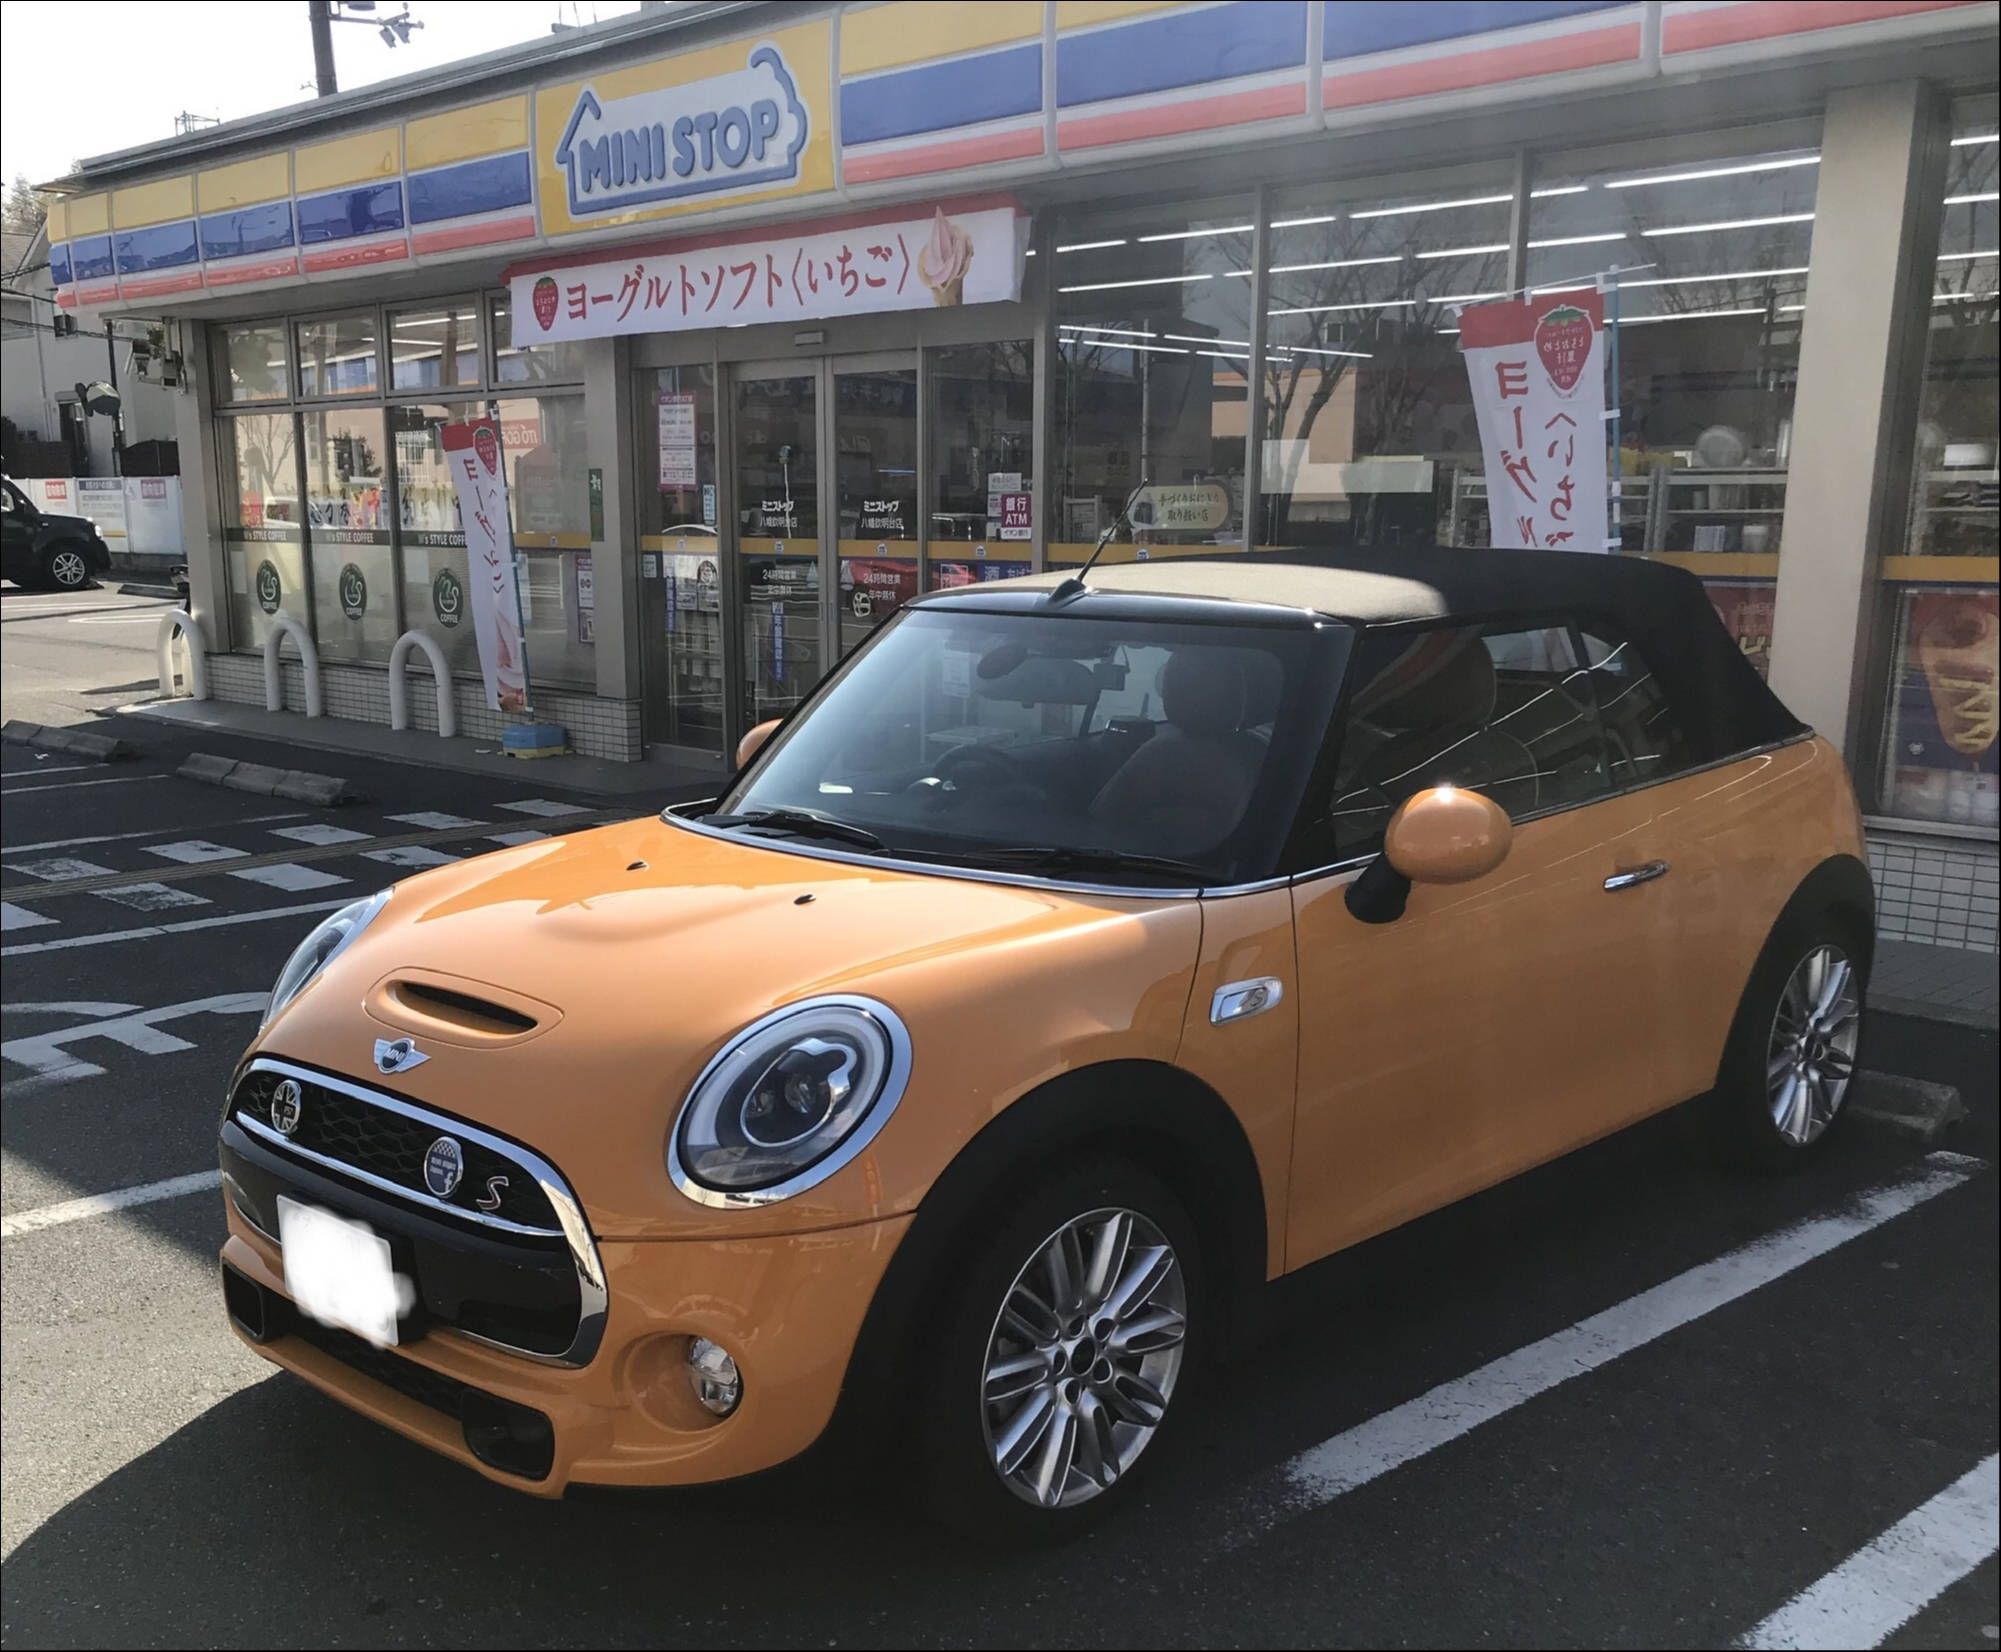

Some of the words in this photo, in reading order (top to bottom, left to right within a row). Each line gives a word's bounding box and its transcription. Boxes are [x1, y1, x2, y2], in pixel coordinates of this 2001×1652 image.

[579, 121, 666, 193] MINI
[672, 98, 779, 177] STOP
[1005, 497, 1027, 511] 銀行
[1159, 491, 1219, 507] 手づくりおにぎり
[761, 500, 795, 512] ミニストップ
[863, 500, 900, 513] ミニストップ
[1005, 513, 1028, 525] ATM
[1167, 508, 1209, 522] 取り扱い店
[252, 530, 267, 541] STYLE
[267, 531, 287, 541] COFFEE
[336, 532, 352, 542] STYLE
[353, 532, 374, 543] COFFEE
[430, 534, 448, 545] STYLE
[449, 534, 468, 546] COFF
[762, 569, 797, 580] 24時間営業
[863, 573, 901, 585] 24時間営業
[868, 590, 897, 600] 年中無休
[262, 600, 278, 611] COFFEE
[345, 606, 362, 617] COFFEE
[440, 613, 458, 624] COFFEE
[384, 1047, 405, 1062] MINI
[475, 1175, 510, 1211] S
